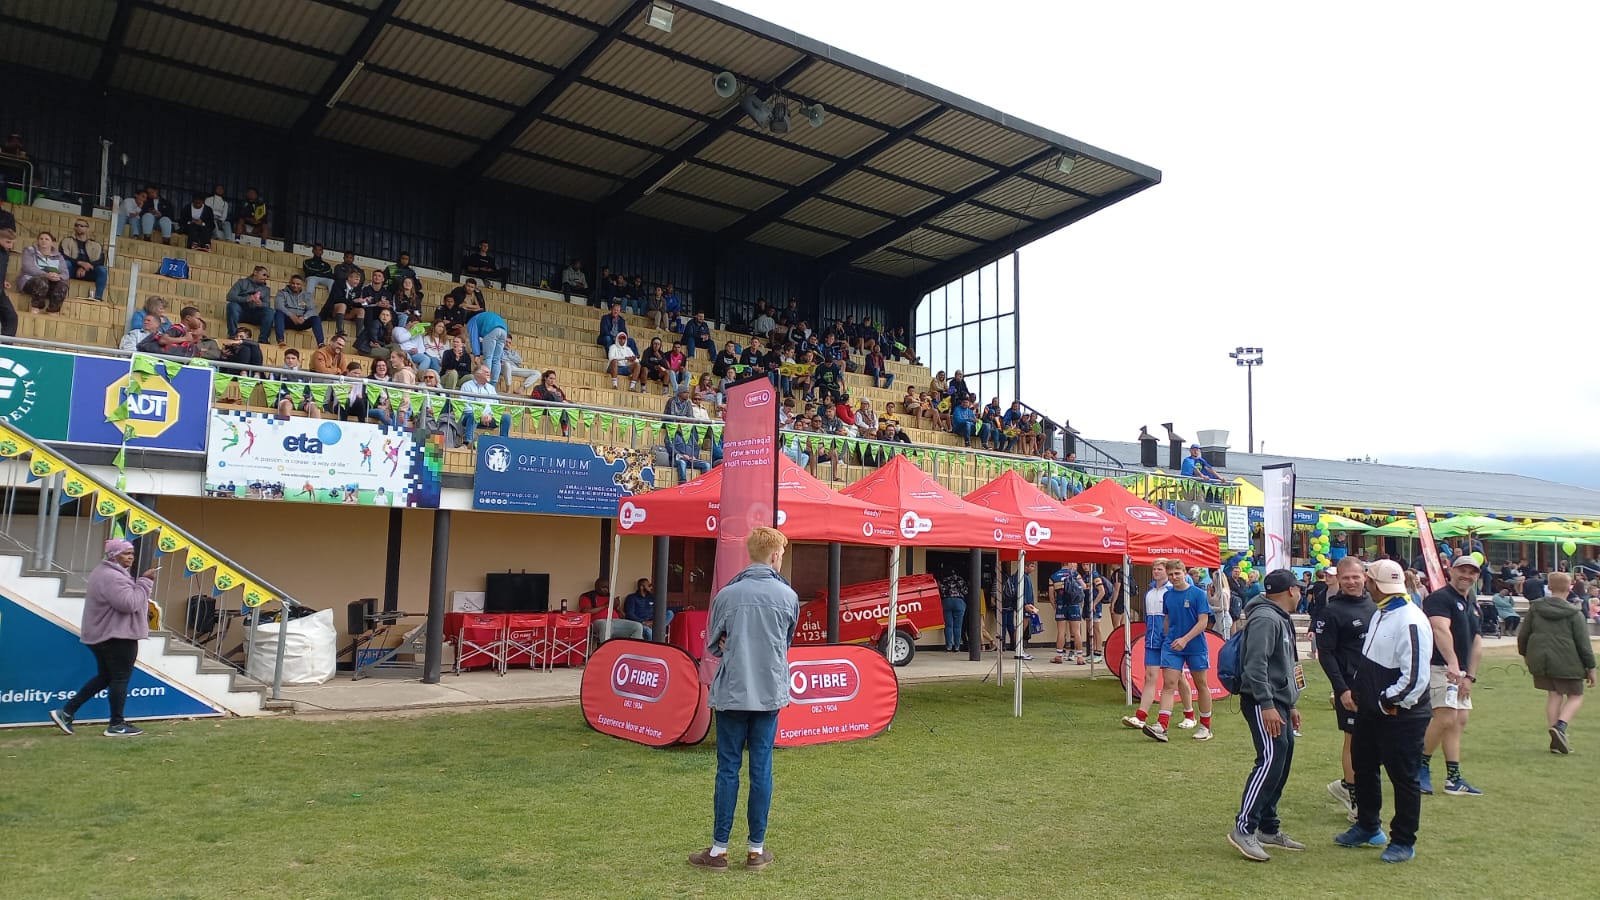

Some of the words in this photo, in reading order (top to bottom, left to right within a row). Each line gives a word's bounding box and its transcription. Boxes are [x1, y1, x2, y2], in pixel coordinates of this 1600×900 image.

[127, 392, 168, 416] ADT
[283, 433, 323, 454] eta
[518, 454, 589, 470] OPTIMUM
[1200, 510, 1225, 526] CAW
[1147, 547, 1173, 555] Experience
[802, 620, 821, 631] dial
[630, 669, 659, 688] FIBRE
[811, 673, 847, 689] FIBRE
[598, 714, 625, 729] Experience
[625, 720, 639, 732] More
[638, 725, 646, 733] at
[645, 726, 662, 738] Home
[780, 727, 821, 739] Experience
[822, 725, 840, 734] More
